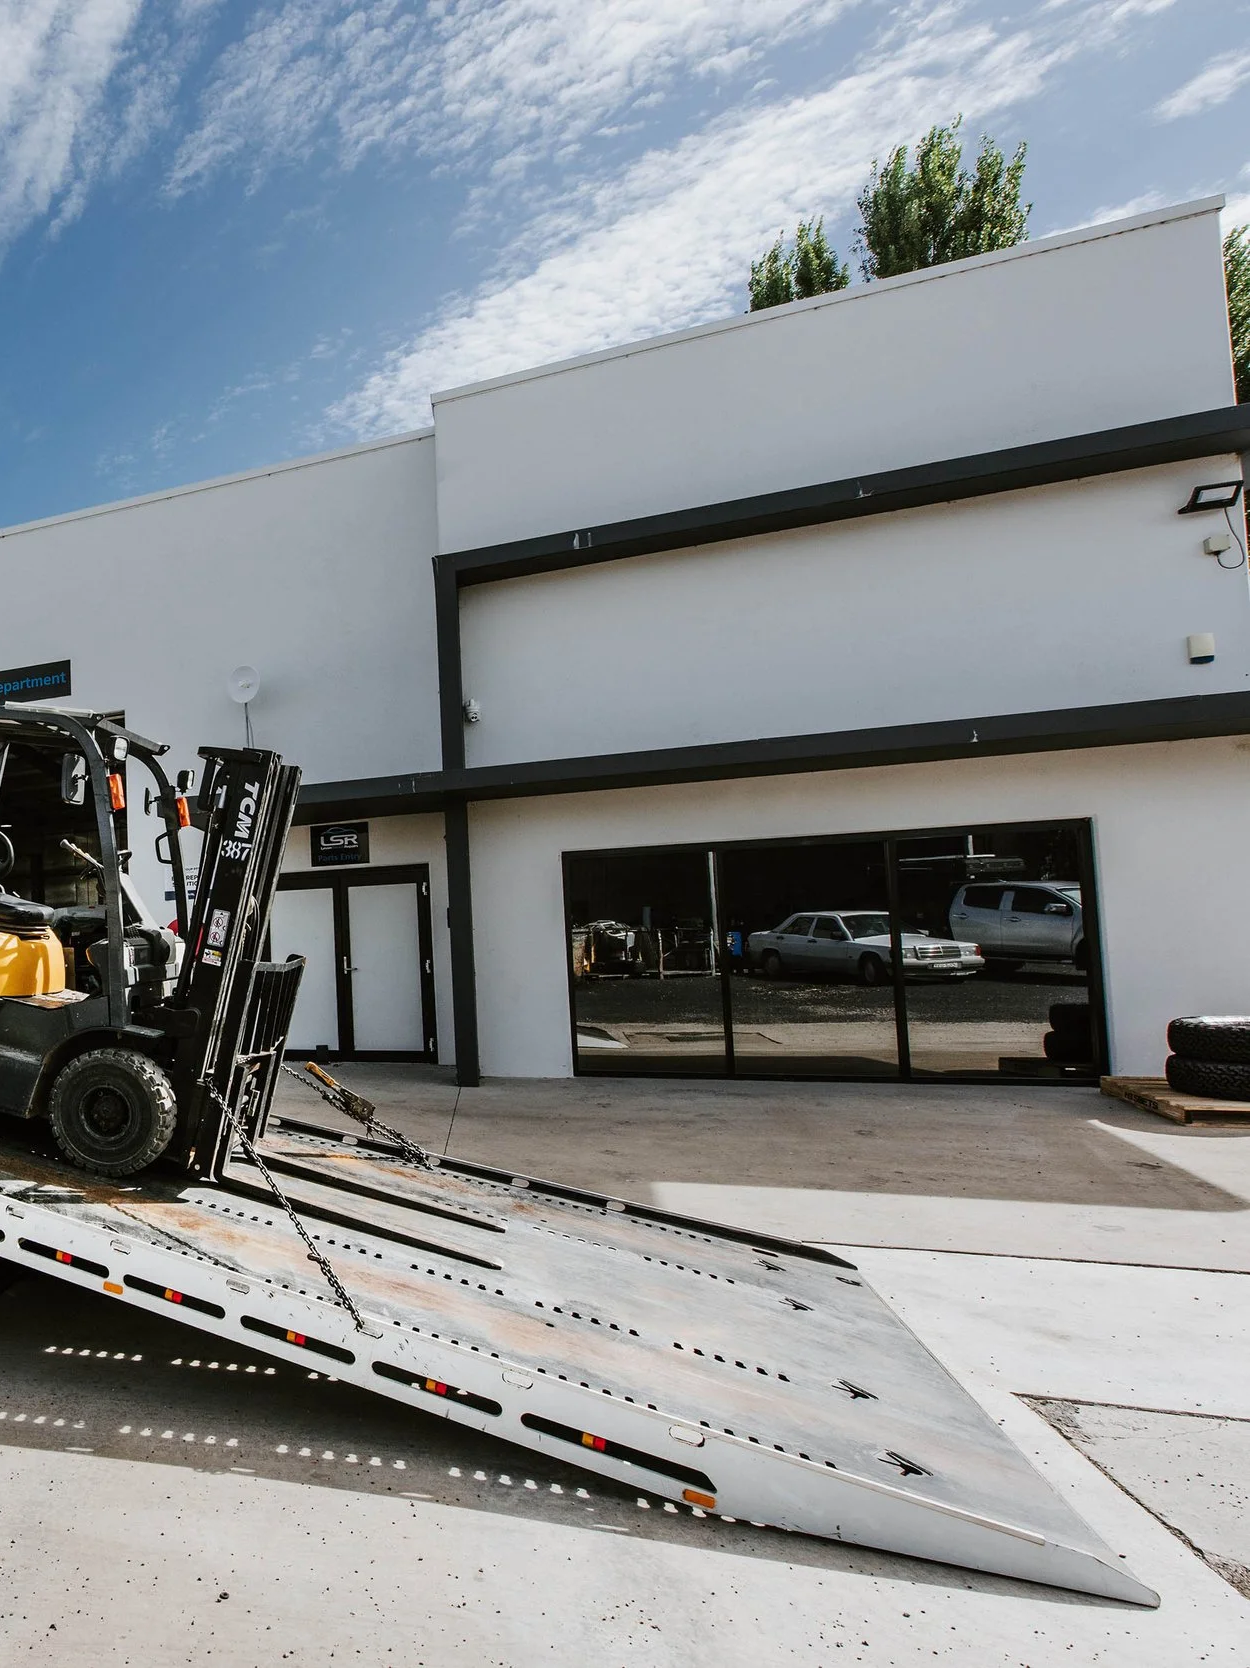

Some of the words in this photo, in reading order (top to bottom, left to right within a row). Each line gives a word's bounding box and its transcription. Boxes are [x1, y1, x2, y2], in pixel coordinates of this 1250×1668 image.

[234, 781, 260, 839] TCM
[221, 839, 252, 861] 387
[320, 833, 358, 847] LSR
